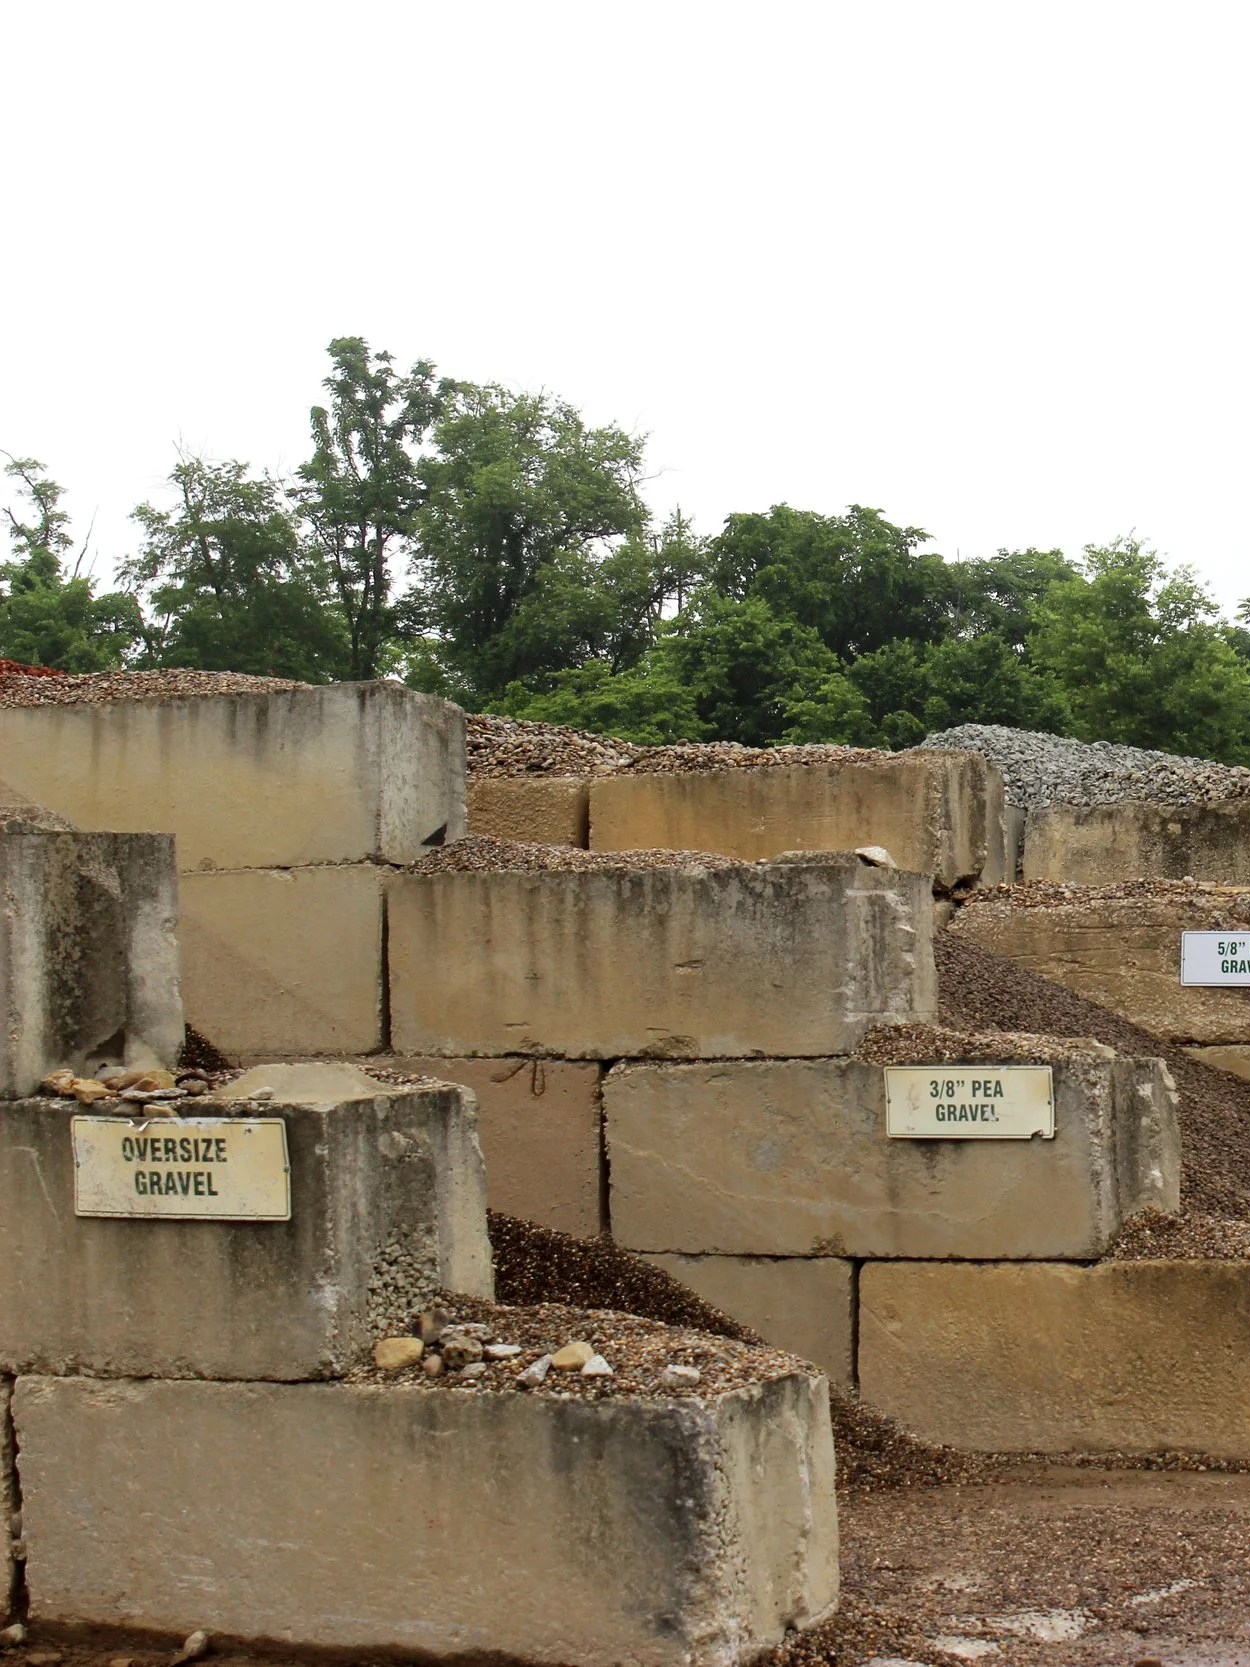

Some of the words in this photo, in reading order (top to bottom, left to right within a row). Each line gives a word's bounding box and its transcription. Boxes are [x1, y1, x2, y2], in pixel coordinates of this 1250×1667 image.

[971, 1080, 1005, 1098] PEA
[935, 1103, 1000, 1122] GRAVEL
[121, 1136, 228, 1163] OVERSIZE
[134, 1170, 219, 1197] GRAVEL
